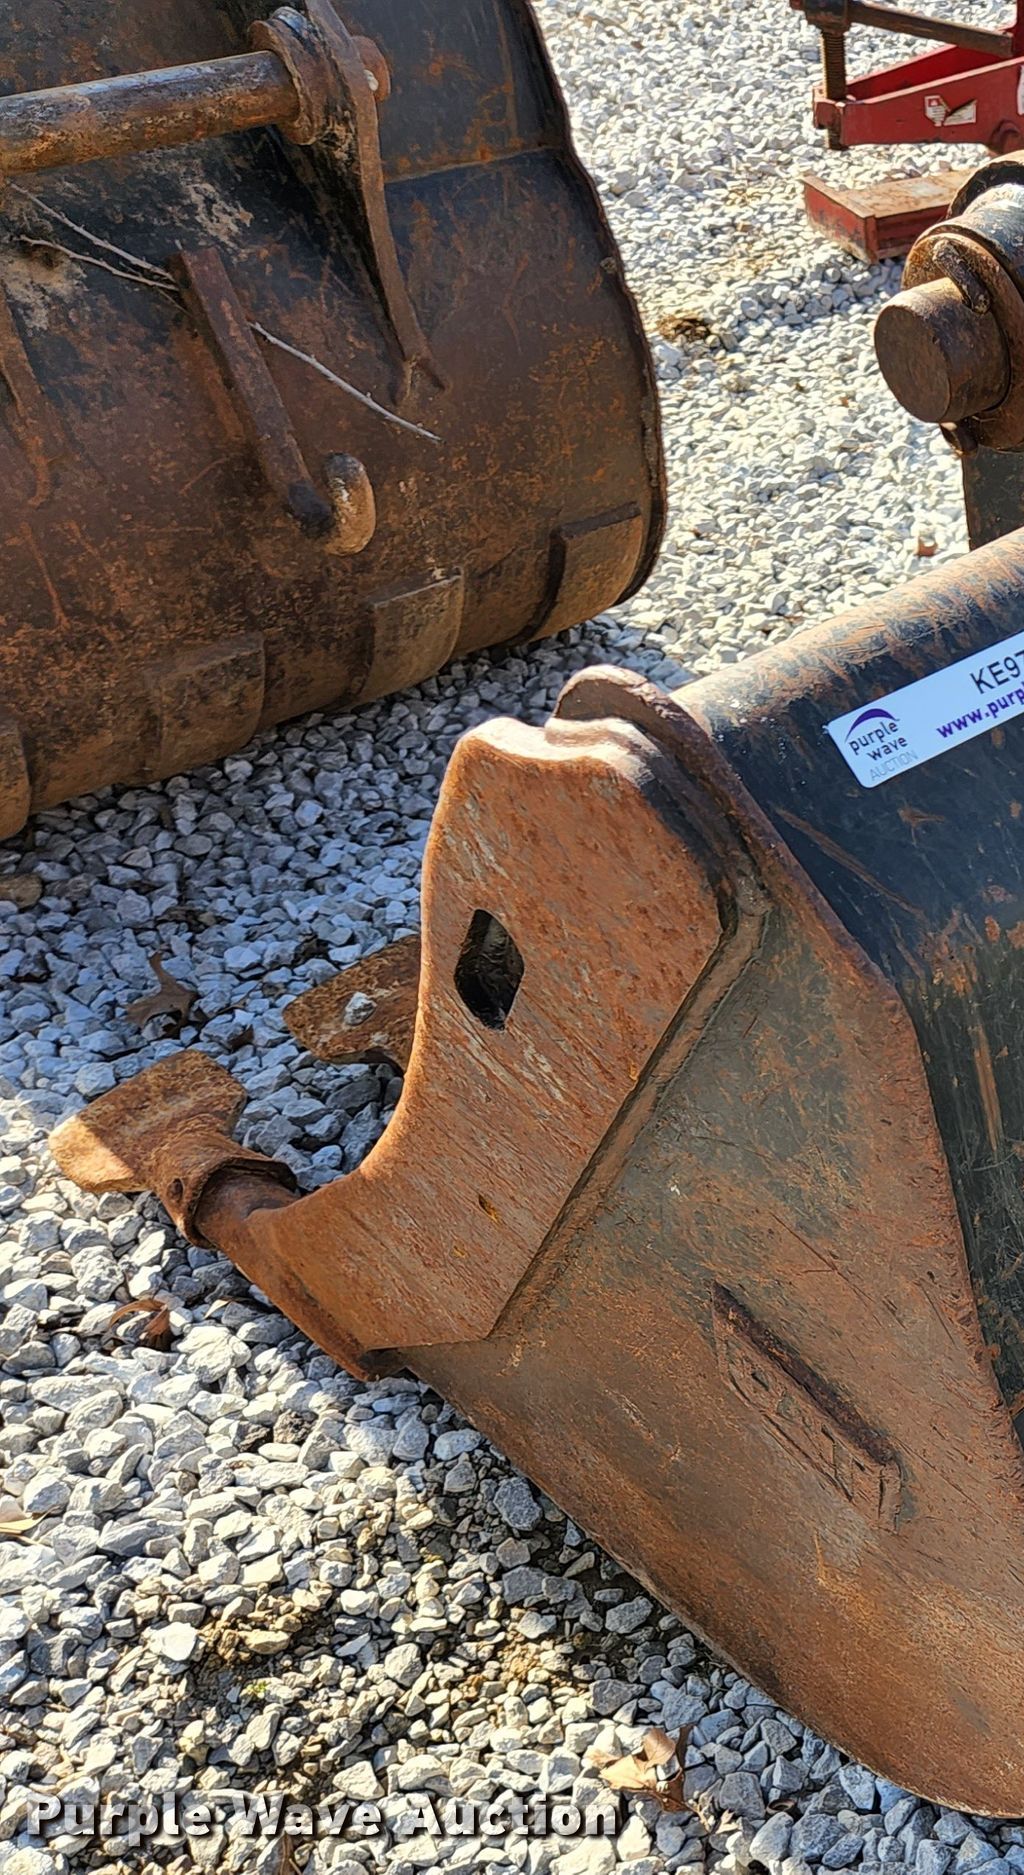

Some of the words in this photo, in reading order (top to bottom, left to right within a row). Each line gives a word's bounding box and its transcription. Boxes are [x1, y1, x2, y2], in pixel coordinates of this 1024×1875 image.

[848, 719, 900, 756] purple
[866, 735, 908, 761] wave
[869, 749, 918, 782] AUCTION
